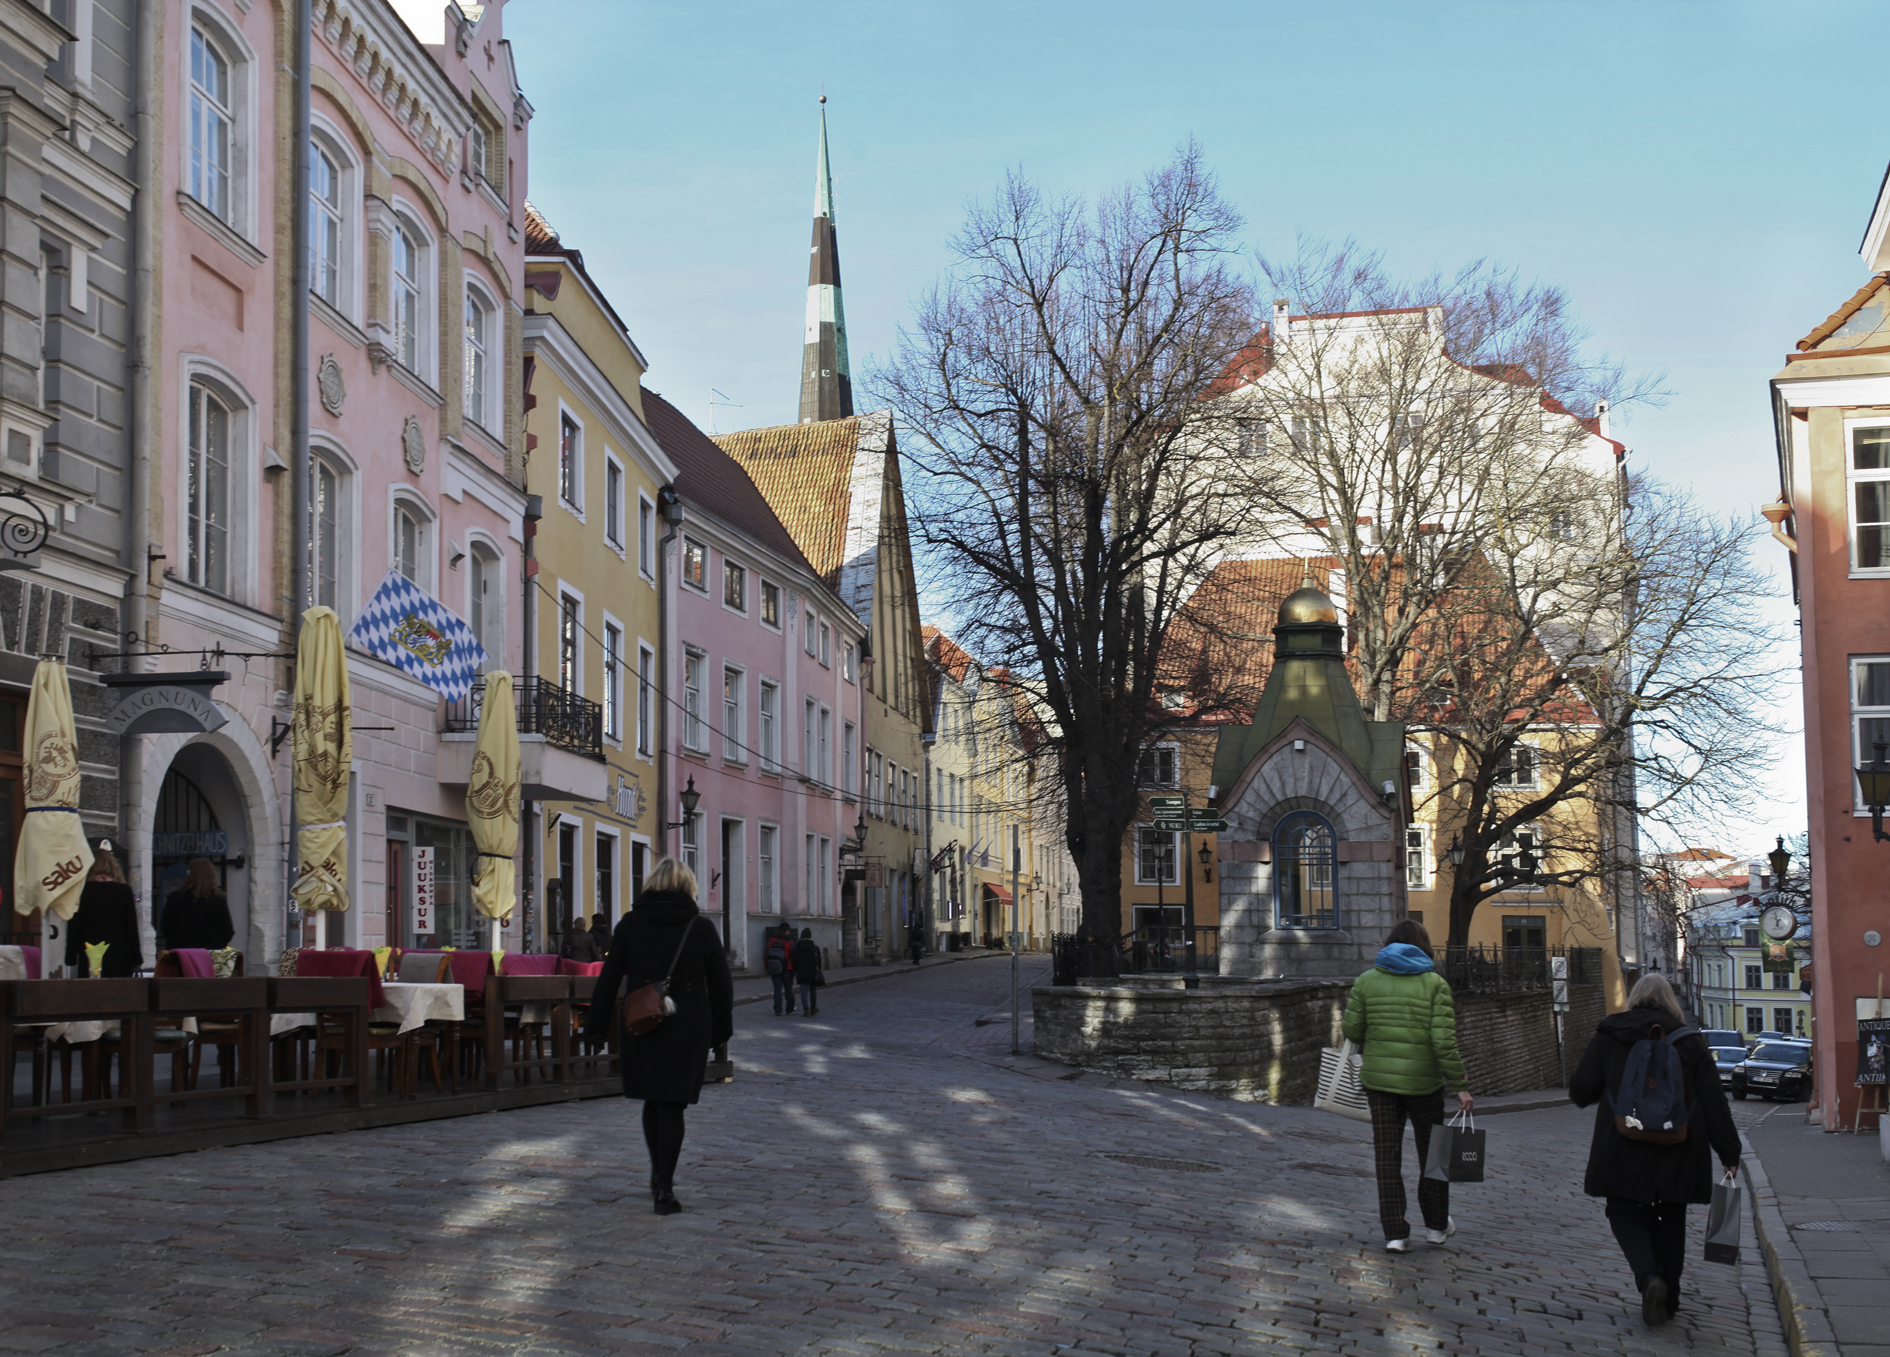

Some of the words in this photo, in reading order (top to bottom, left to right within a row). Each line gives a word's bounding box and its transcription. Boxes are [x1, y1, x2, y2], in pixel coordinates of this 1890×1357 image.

[114, 690, 211, 727] MAGNUNA
[153, 832, 227, 854] CHNITZELHAUS
[42, 855, 84, 892] saku
[417, 849, 428, 929] JUUKSUR
